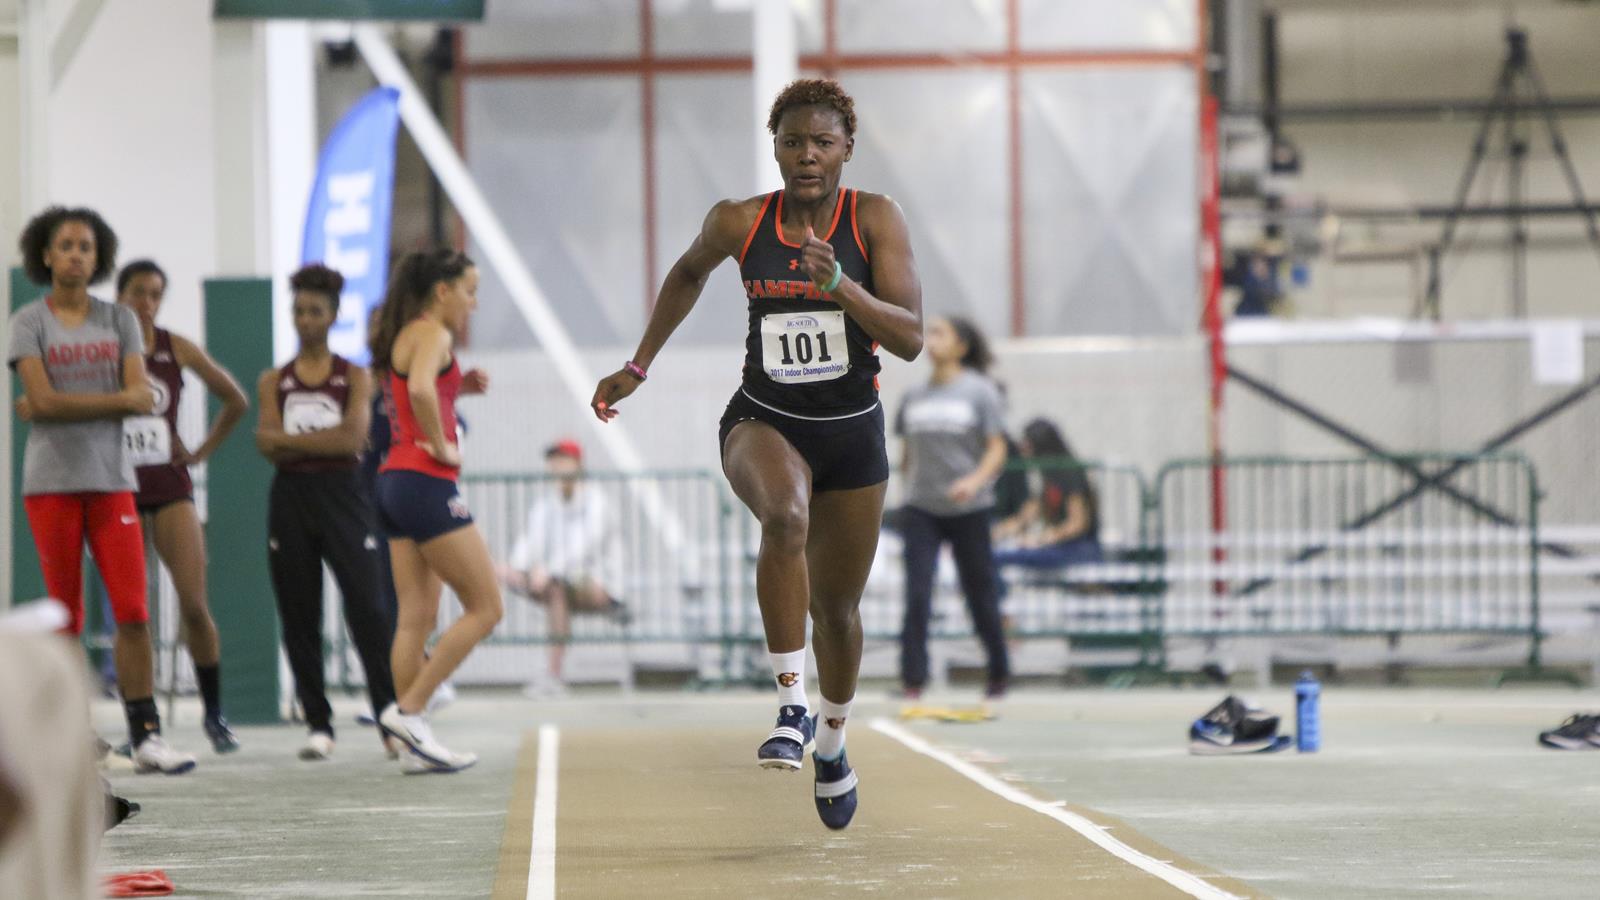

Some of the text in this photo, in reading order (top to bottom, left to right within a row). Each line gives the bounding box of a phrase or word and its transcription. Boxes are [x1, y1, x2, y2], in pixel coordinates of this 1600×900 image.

[325, 172, 373, 357] UTH
[779, 331, 832, 365] 101
[770, 364, 843, 377] 2017 Indoor Championships
